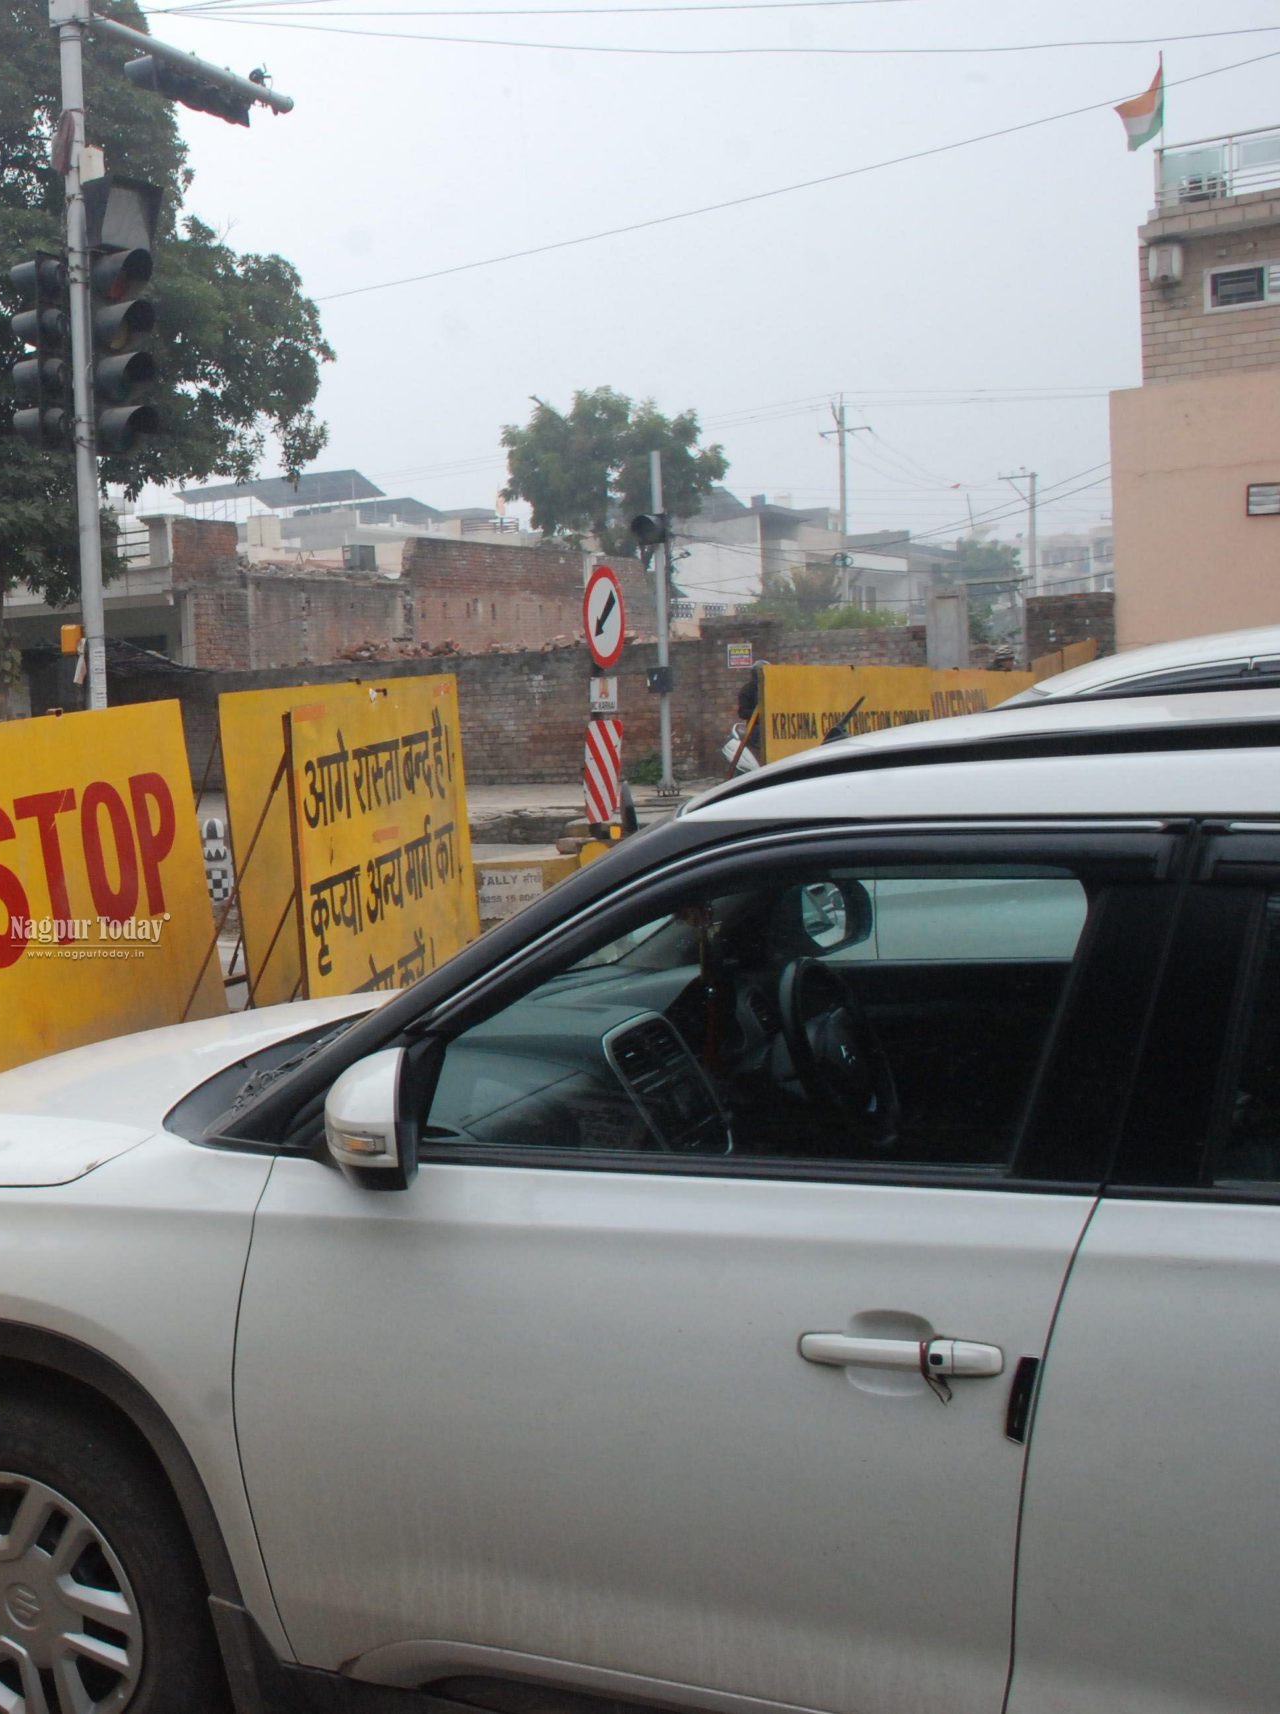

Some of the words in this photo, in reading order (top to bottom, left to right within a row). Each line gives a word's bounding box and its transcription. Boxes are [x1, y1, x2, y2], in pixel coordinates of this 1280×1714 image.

[771, 712, 818, 740] KRISHNA
[303, 728, 351, 829] आगे
[352, 738, 402, 814] रास्ता
[401, 730, 434, 798] बन्द
[366, 848, 404, 924] अन्य
[404, 814, 434, 900] मार्ग
[434, 822, 455, 880] का
[479, 874, 517, 886] TALLY
